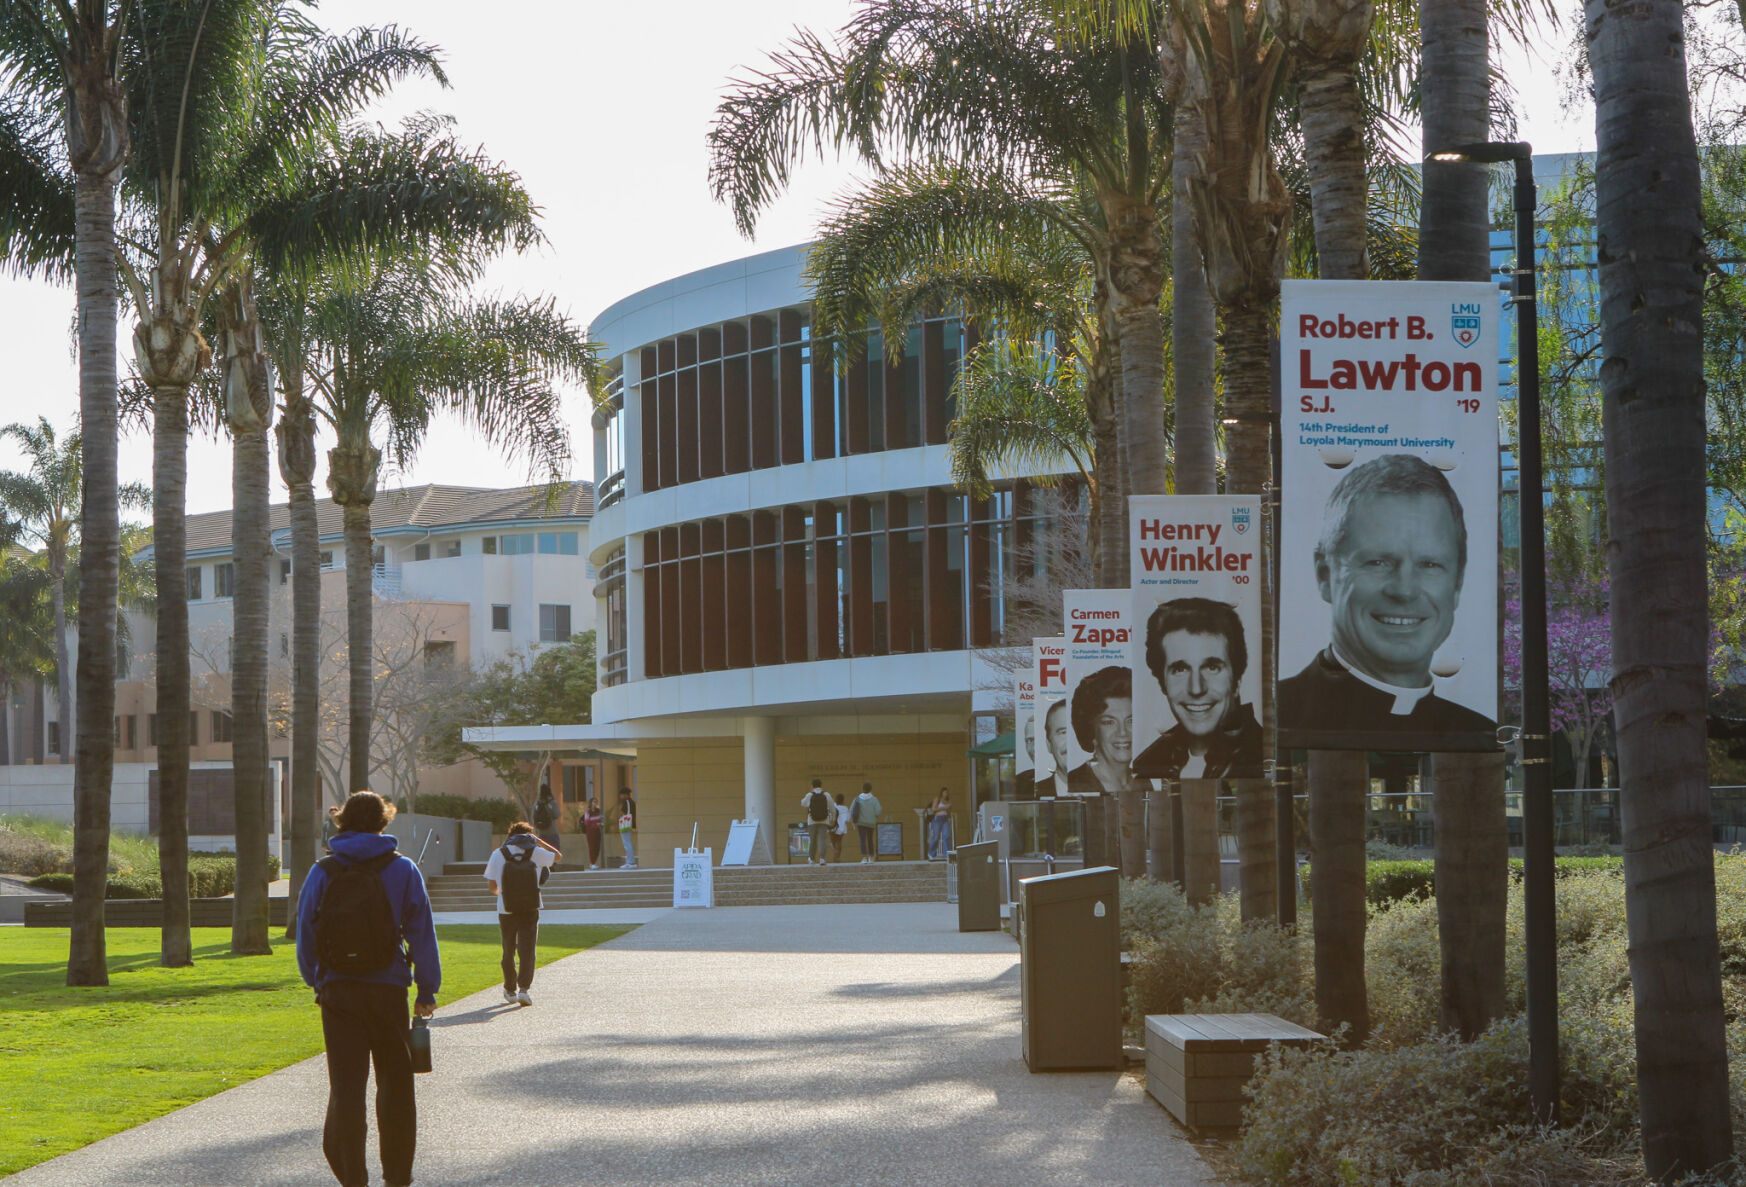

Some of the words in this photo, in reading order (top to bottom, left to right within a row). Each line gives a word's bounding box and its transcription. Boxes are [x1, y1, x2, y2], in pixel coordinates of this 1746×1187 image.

[1452, 303, 1481, 315] LMU
[1299, 313, 1400, 340] Robert
[1406, 315, 1434, 341] B.
[1300, 348, 1482, 392] Lawton
[1300, 395, 1336, 413] S.J.
[1456, 398, 1480, 413] '19
[1300, 422, 1323, 433] 14th
[1325, 422, 1375, 434] President
[1377, 423, 1389, 434] of
[1300, 436, 1335, 448] Loyola
[1337, 436, 1398, 449] Marymount
[1400, 437, 1456, 449] University
[1232, 507, 1250, 515] LMU
[1140, 518, 1222, 545] Henry
[1139, 546, 1253, 572] Winkler
[1231, 575, 1250, 585] '00
[1071, 608, 1120, 620] Carmen
